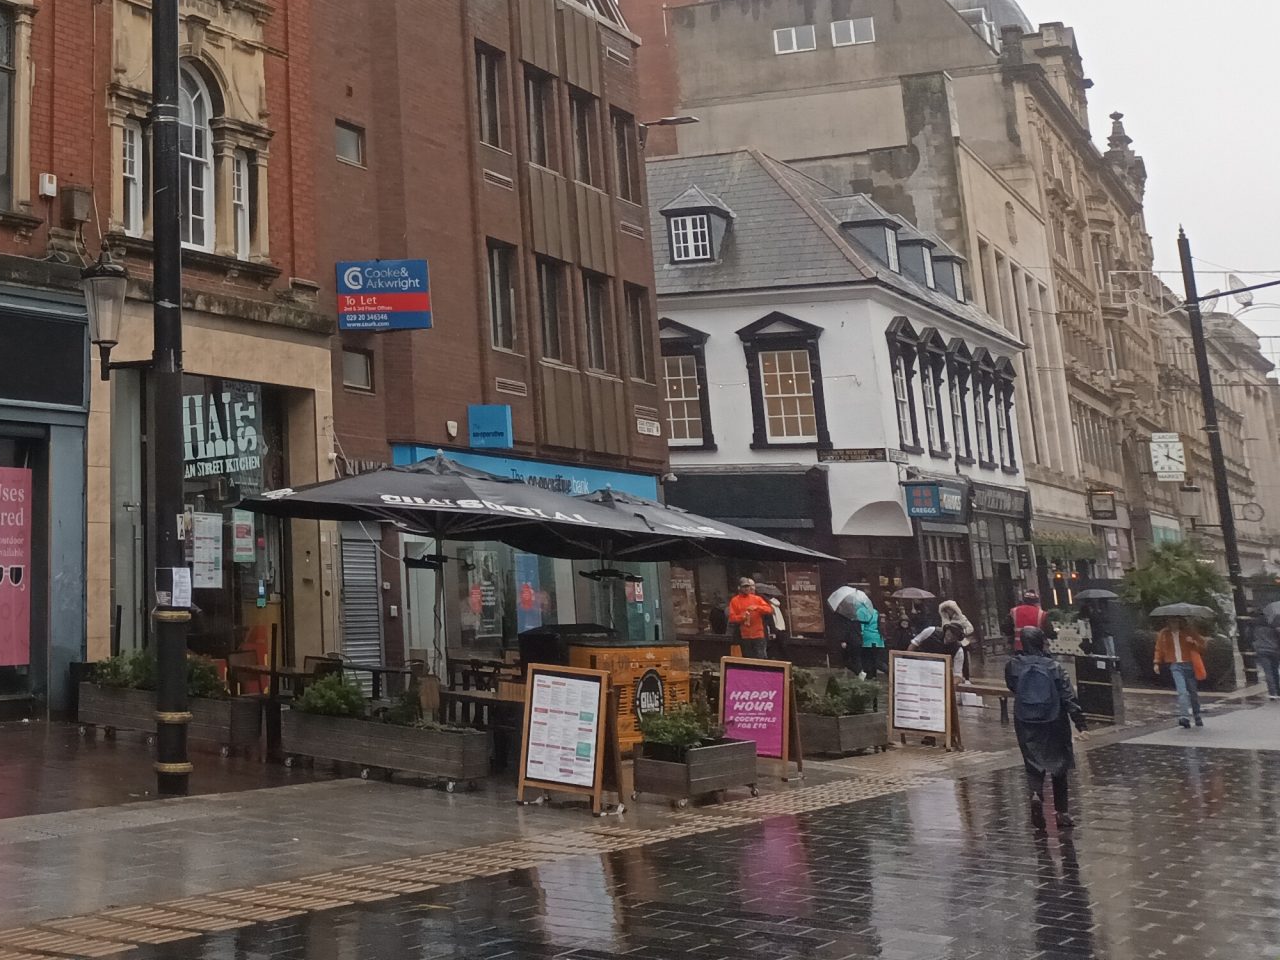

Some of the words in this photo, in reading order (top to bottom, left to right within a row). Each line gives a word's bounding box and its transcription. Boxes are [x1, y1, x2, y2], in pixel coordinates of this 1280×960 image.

[366, 278, 420, 290] Arkwright
[344, 295, 356, 306] To
[360, 295, 377, 305] Let
[197, 460, 224, 476] STREET
[225, 456, 260, 473] KITCHEN
[572, 476, 590, 494] bank
[729, 690, 777, 700] HAPPY
[733, 701, 774, 712] HOUR
